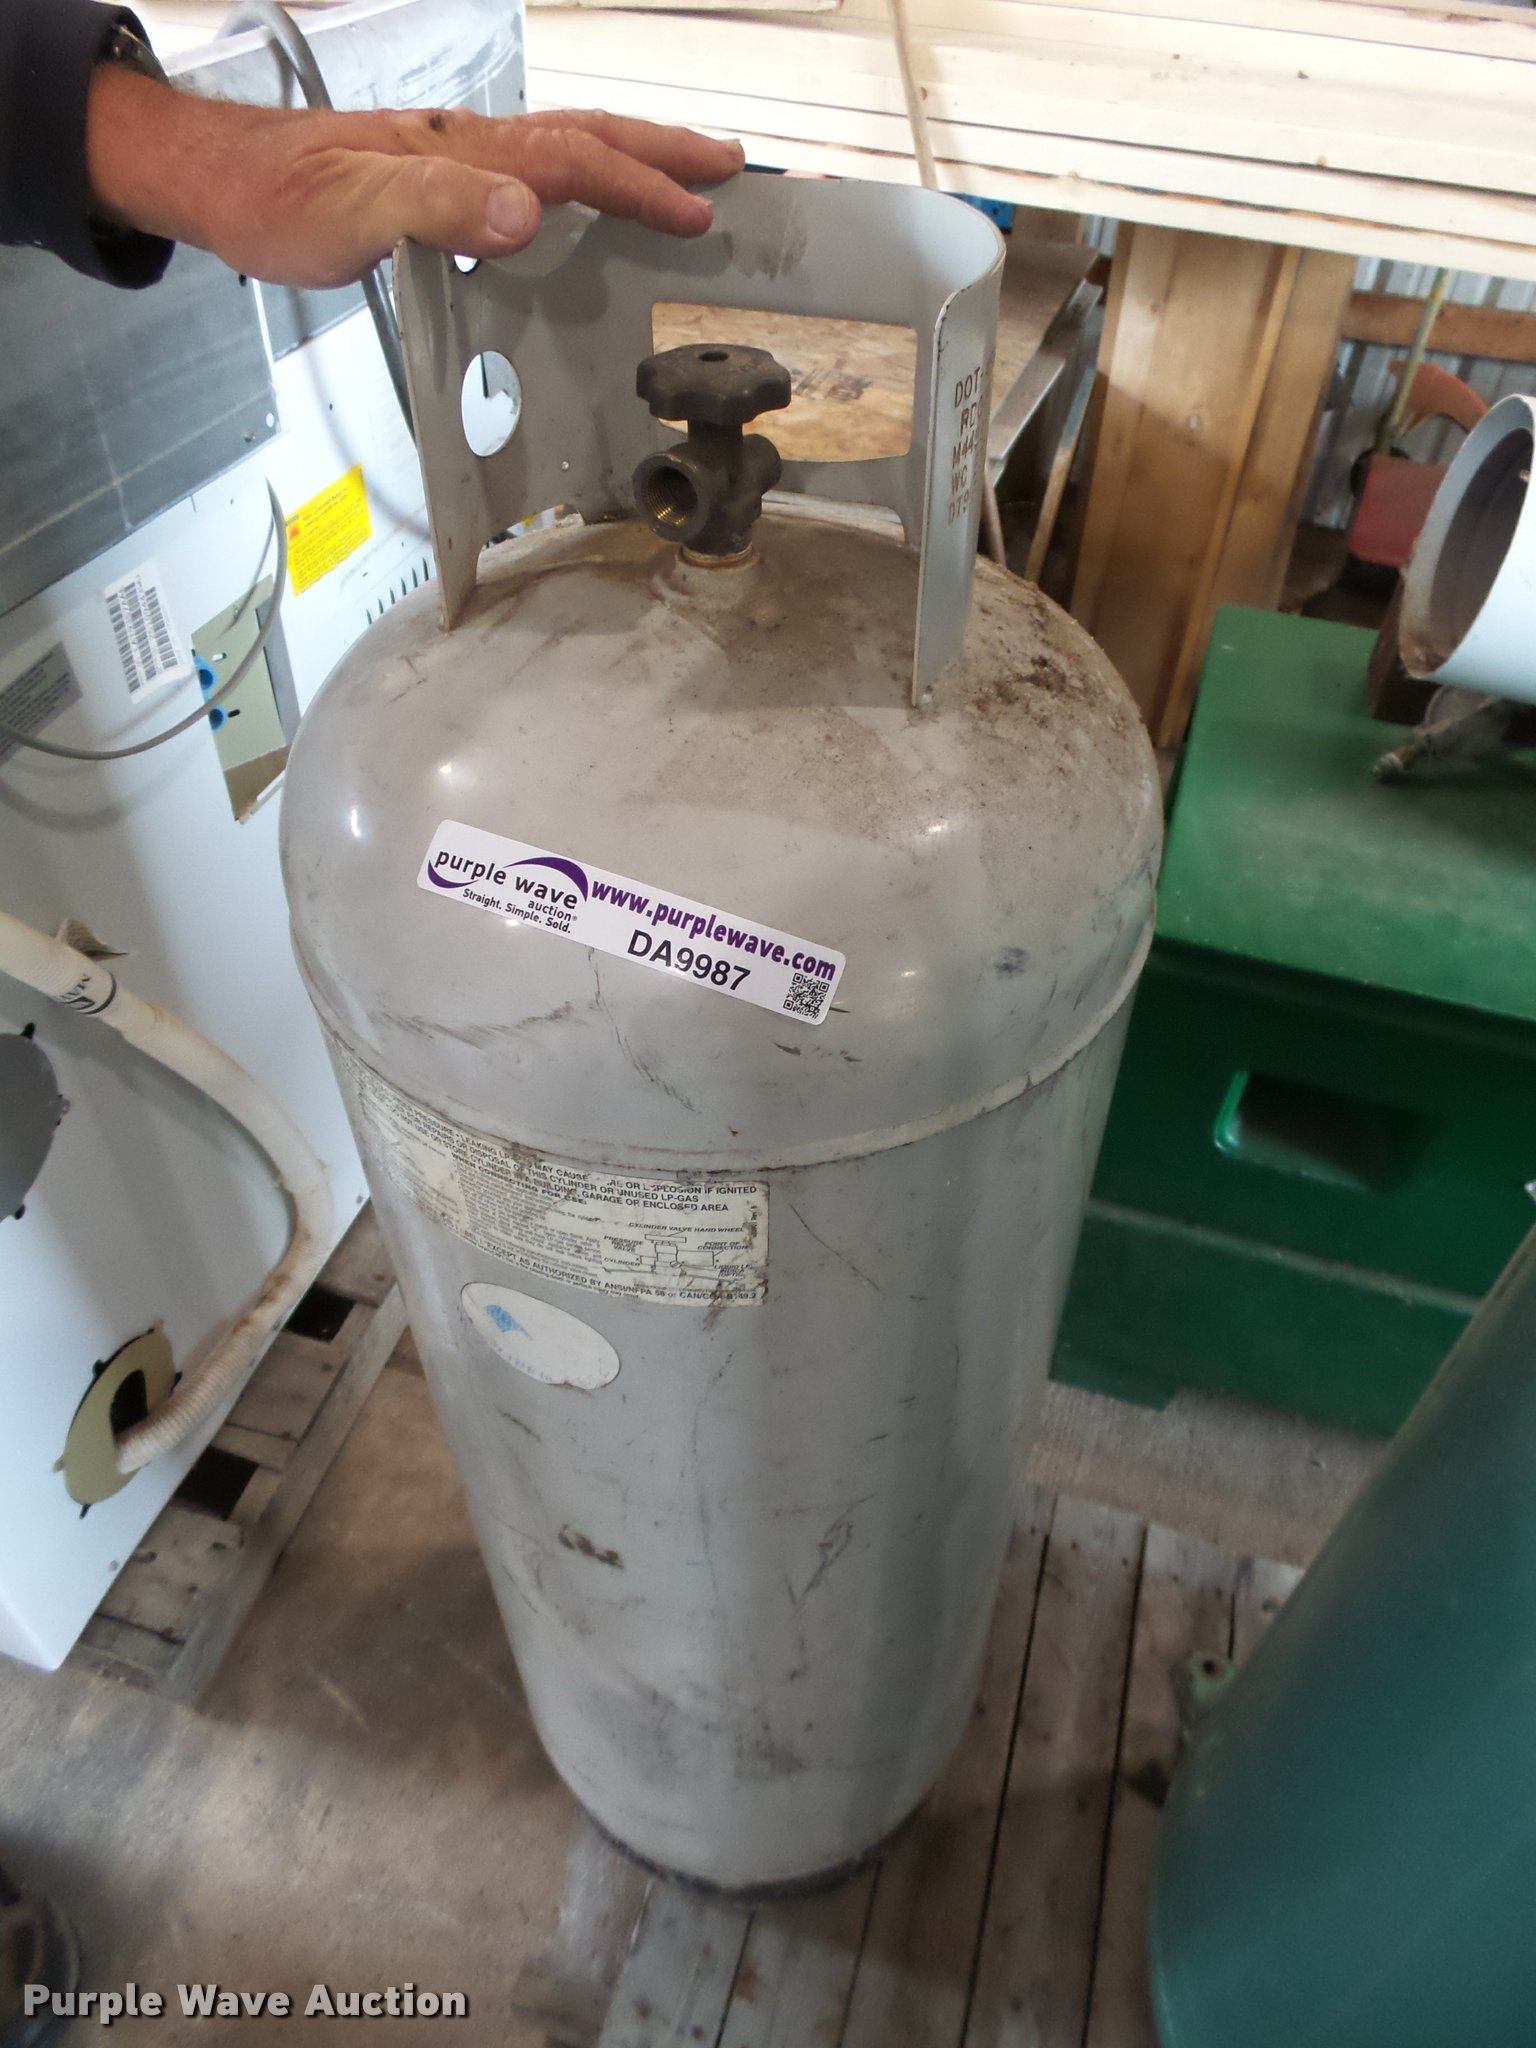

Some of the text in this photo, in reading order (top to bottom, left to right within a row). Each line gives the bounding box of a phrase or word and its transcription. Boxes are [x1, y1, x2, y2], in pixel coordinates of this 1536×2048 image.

[434, 849, 578, 910] purple wave
[463, 888, 571, 934] Straight. Simple. Sold.
[591, 880, 836, 981] www.purplewave.com
[627, 929, 751, 991] DA9987
[549, 1175, 598, 1192] CYLINDER
[599, 1185, 614, 1195] OR
[617, 1189, 658, 1200] UNUSED
[661, 1194, 699, 1203] LP-GAS
[556, 1169, 589, 1181] CAUSE
[626, 1181, 640, 1190] OR
[704, 1186, 713, 1195] IF
[716, 1186, 757, 1195] IGNITED
[582, 1190, 622, 1204] GARAGE
[643, 1200, 697, 1211] ENCLOSED
[628, 1222, 667, 1231] CYLINDER
[519, 1257, 531, 1267] AS
[533, 1261, 588, 1284] AUTHORIZED
[589, 1278, 602, 1287] BY
